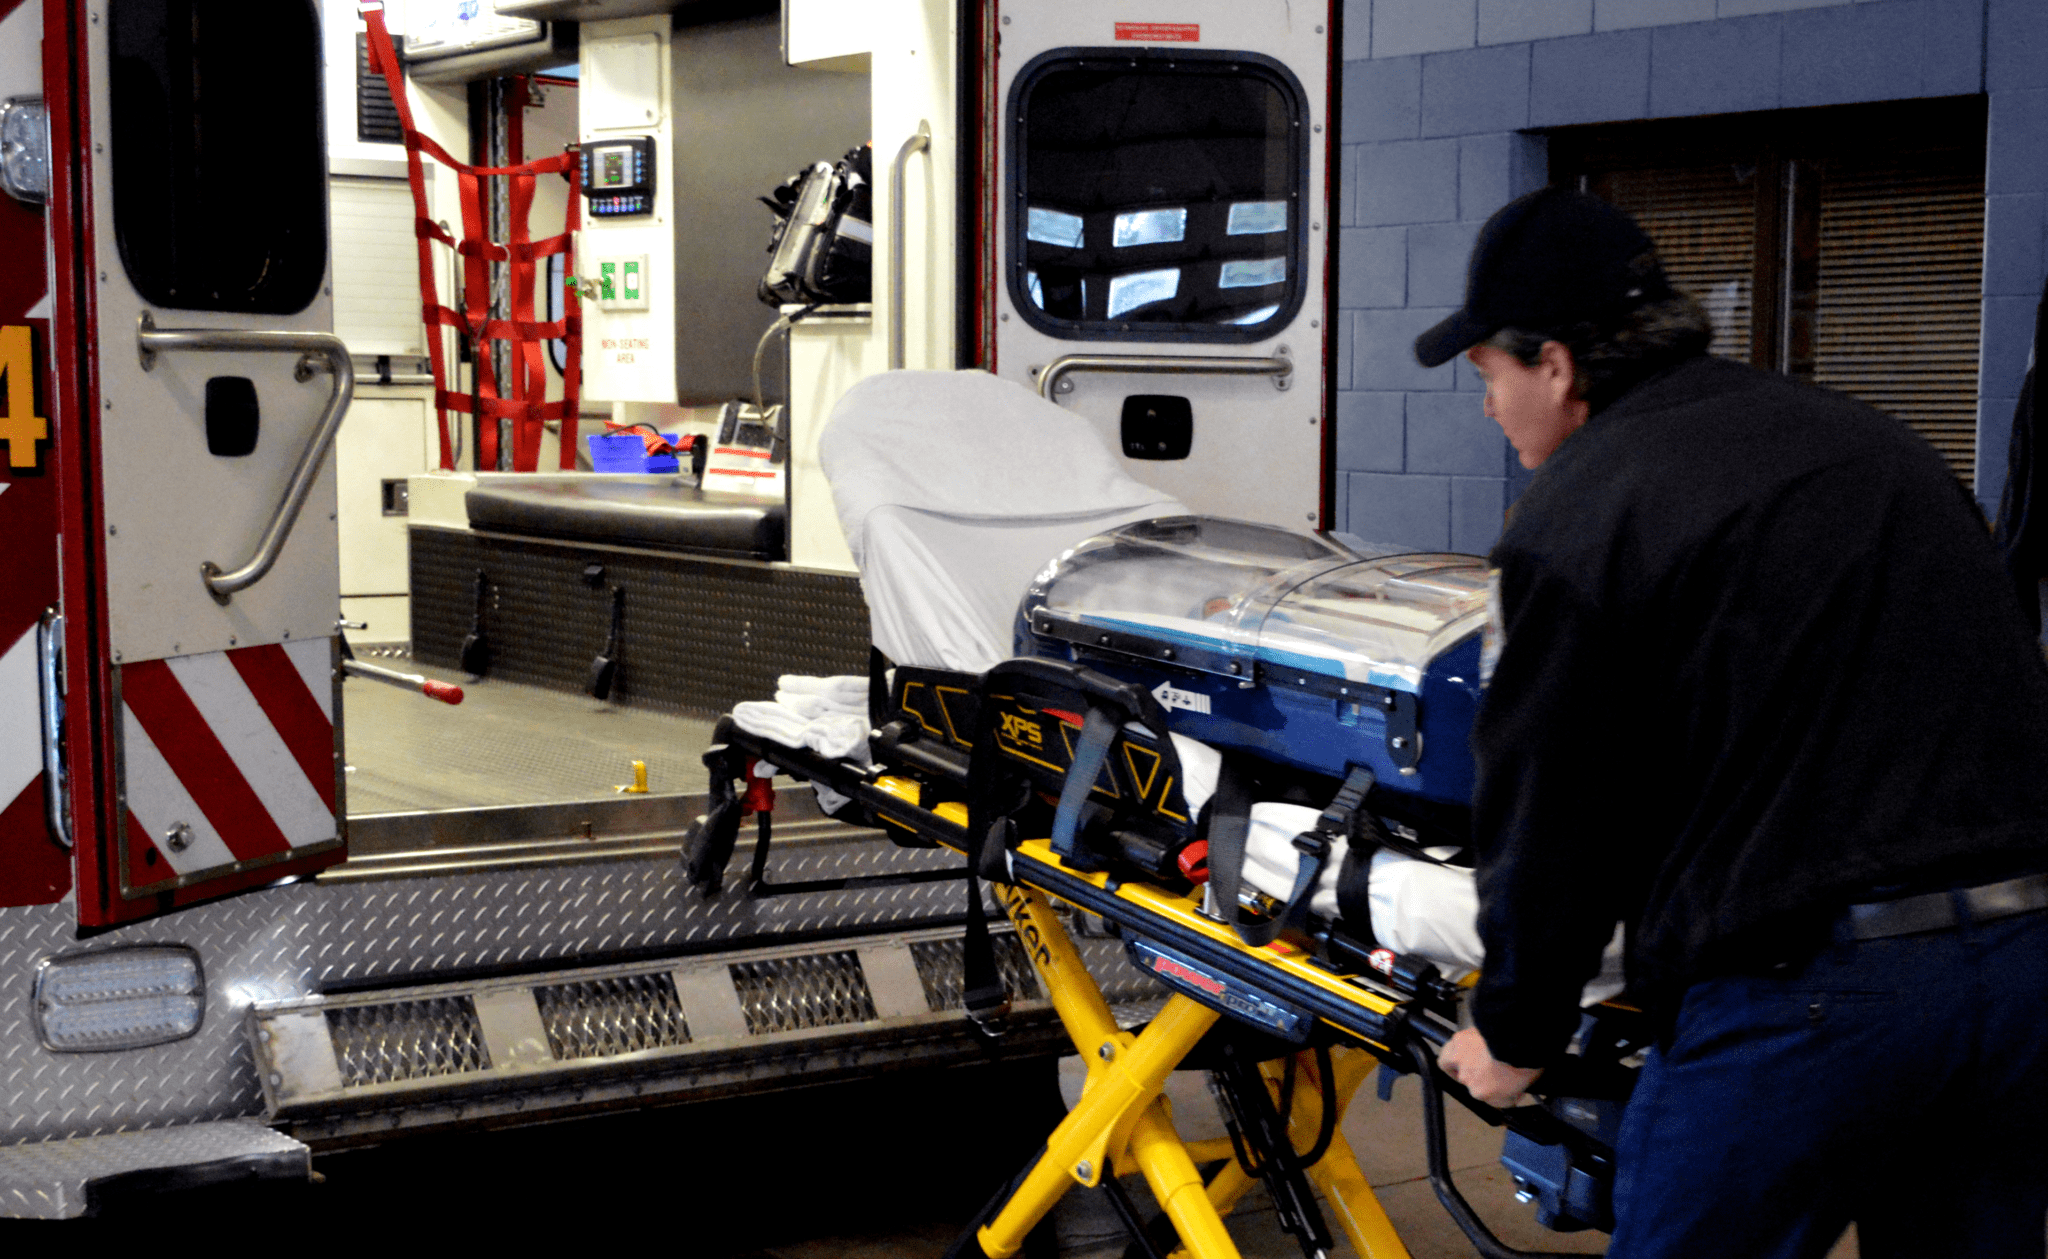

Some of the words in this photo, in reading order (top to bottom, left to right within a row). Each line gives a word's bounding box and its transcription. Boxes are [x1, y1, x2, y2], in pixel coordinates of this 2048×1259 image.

[617, 353, 635, 364] AREA
[0, 325, 47, 467] 4
[1000, 711, 1042, 743] XPS
